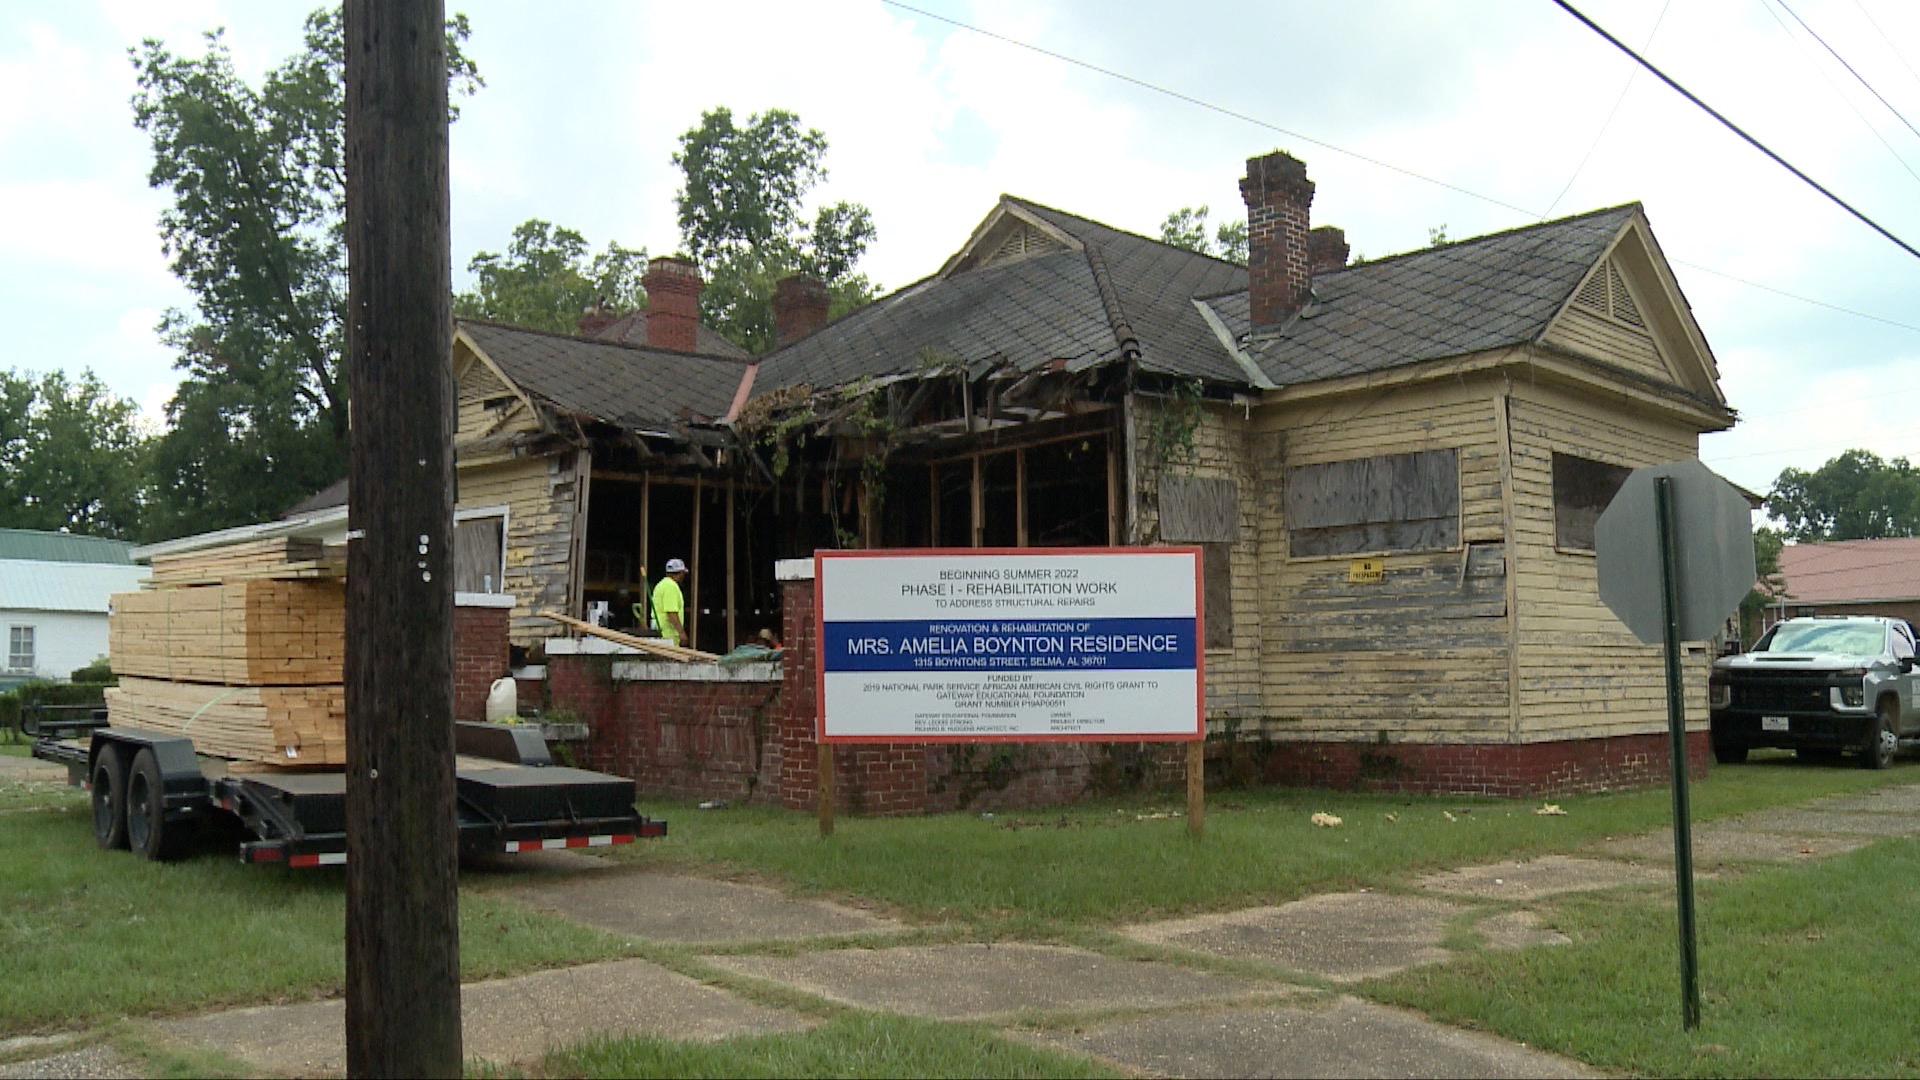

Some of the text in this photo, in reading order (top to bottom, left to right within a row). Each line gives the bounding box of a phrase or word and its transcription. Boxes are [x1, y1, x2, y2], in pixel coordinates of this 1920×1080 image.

[940, 569, 1079, 580] BEGINNING SUMMER 2022
[901, 584, 946, 596] PHASE
[950, 583, 954, 596] I
[966, 583, 1072, 595] REHABILITATION
[1075, 583, 1117, 595] WORK
[935, 598, 1096, 608] TO ADDRESS STRUCTURAL REPAIRS
[929, 623, 1090, 634] RENOVATION & REHABILITATION OF
[848, 635, 1178, 655] MRS. AMELIA BOYNTON RESIDENCE
[914, 658, 932, 668] 1315
[989, 657, 1028, 667] STREET,
[1066, 657, 1079, 666] AL
[1081, 657, 1107, 666] 36701
[863, 681, 1158, 693] 2019 NATIONAL PARK SERVICE AFRICAN AMERICAN CIVIL RIGHTS GRANT TO
[936, 691, 1085, 700] GATEWAY EDUCATIONAL FOUNDATION
[954, 700, 983, 709] GRANT
[985, 700, 1020, 708] NUMBER
